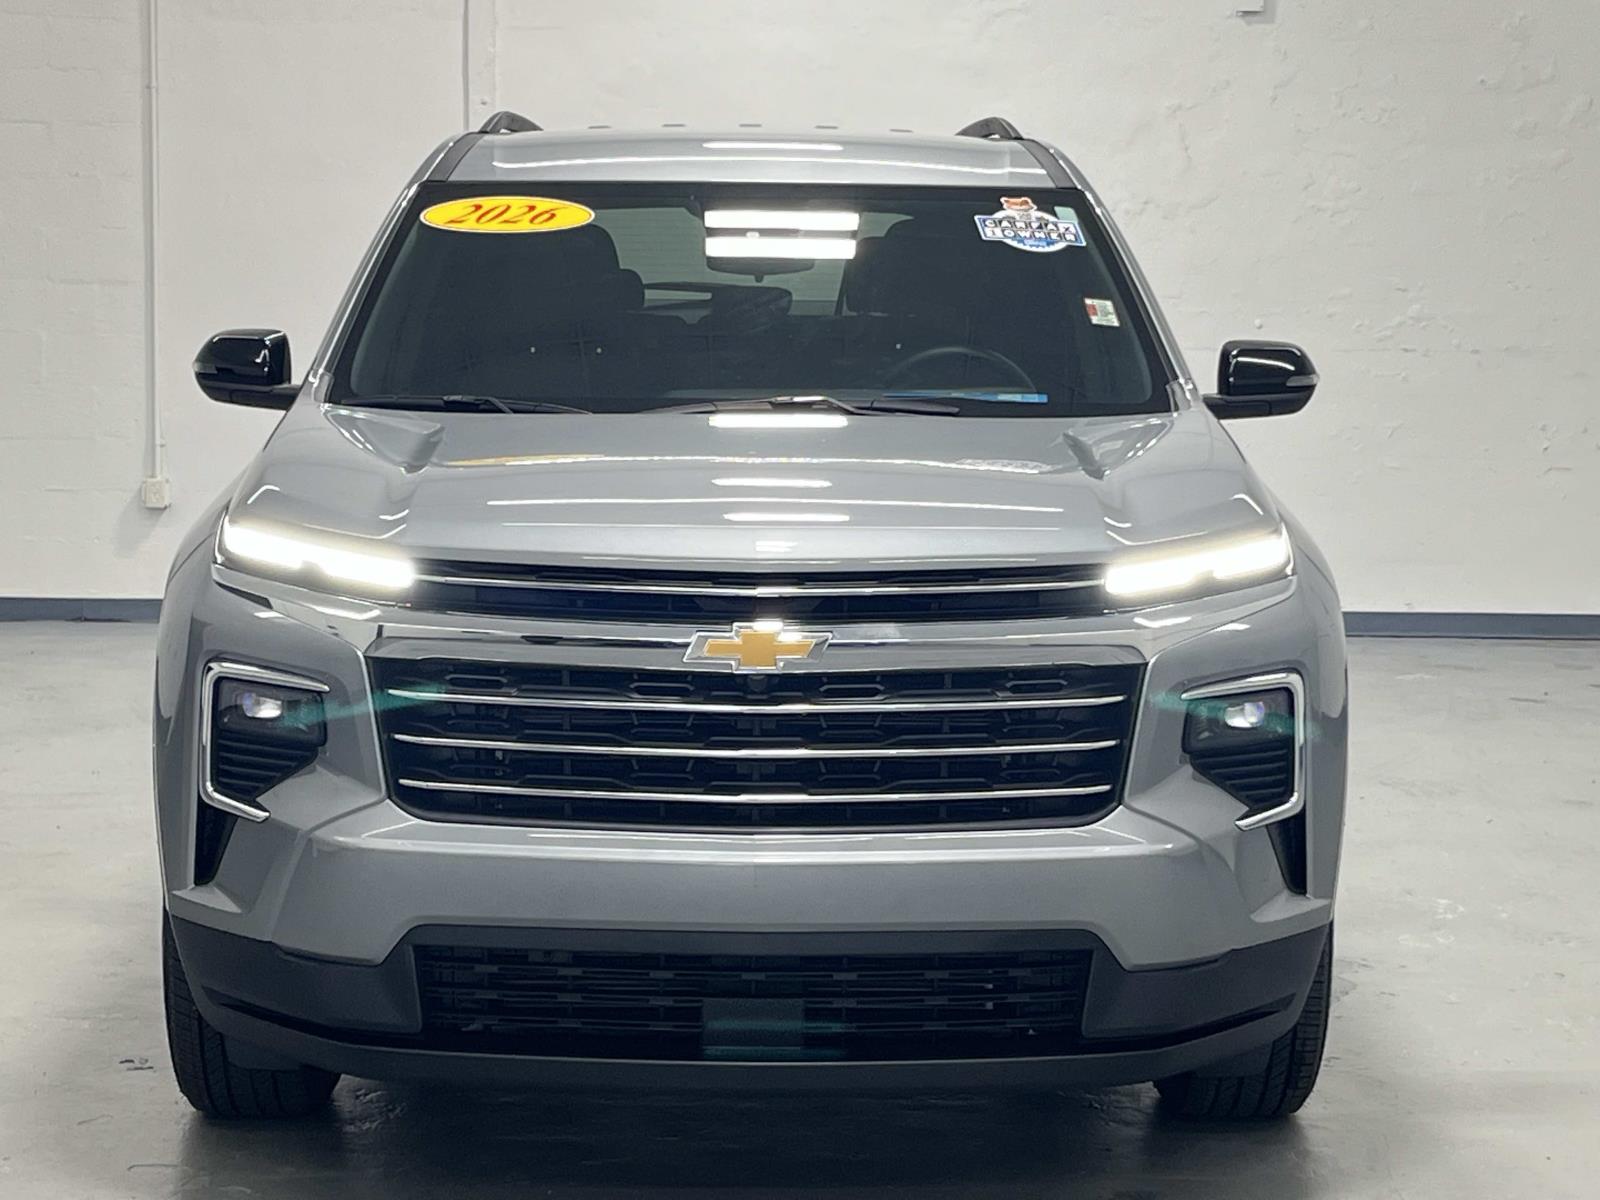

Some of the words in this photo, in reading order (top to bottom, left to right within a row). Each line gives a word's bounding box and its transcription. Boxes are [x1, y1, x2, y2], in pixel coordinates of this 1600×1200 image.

[444, 203, 568, 225] 2026
[984, 219, 1075, 233] CARFAX
[1003, 229, 1076, 241] OWNER
